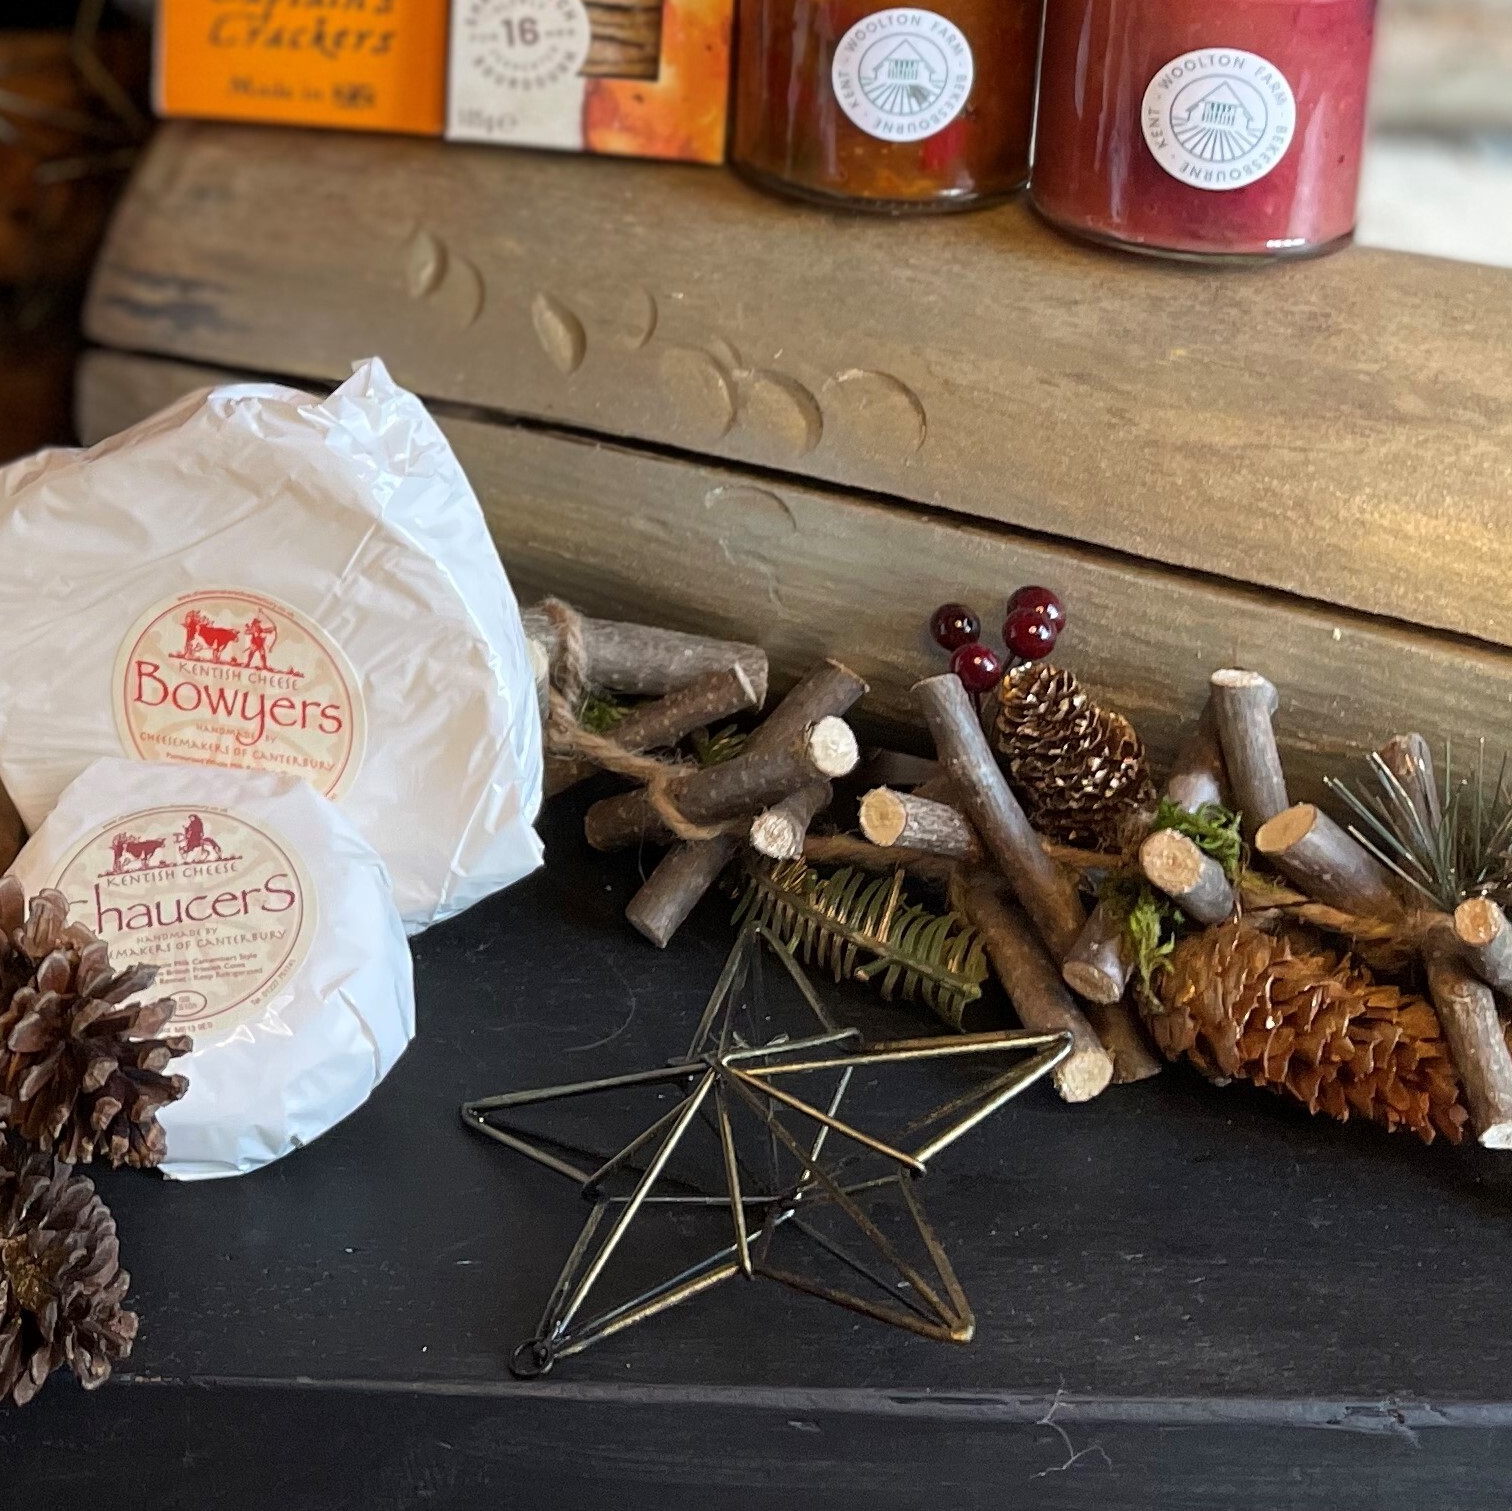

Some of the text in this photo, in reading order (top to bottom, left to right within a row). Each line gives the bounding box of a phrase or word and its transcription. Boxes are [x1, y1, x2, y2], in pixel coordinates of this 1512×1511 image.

[207, 11, 398, 60] Crackers
[501, 16, 540, 48] 16
[838, 14, 967, 134] WOOLTON FARM BEKESBOURNE KENT
[1148, 54, 1288, 183] WOOLTON FARM BEKESBOURNE KENT
[179, 662, 298, 691] KENTISH CHEESE
[133, 660, 343, 746] Bowyers
[140, 731, 229, 755] CHEESEMAKERS
[233, 747, 247, 757] OF
[252, 750, 336, 772] CANTERBURY
[107, 861, 238, 887] KENTISH CHEESE
[136, 928, 218, 944] HANDMADE BY
[175, 941, 191, 951] OF
[196, 929, 287, 948] CANTERBURY
